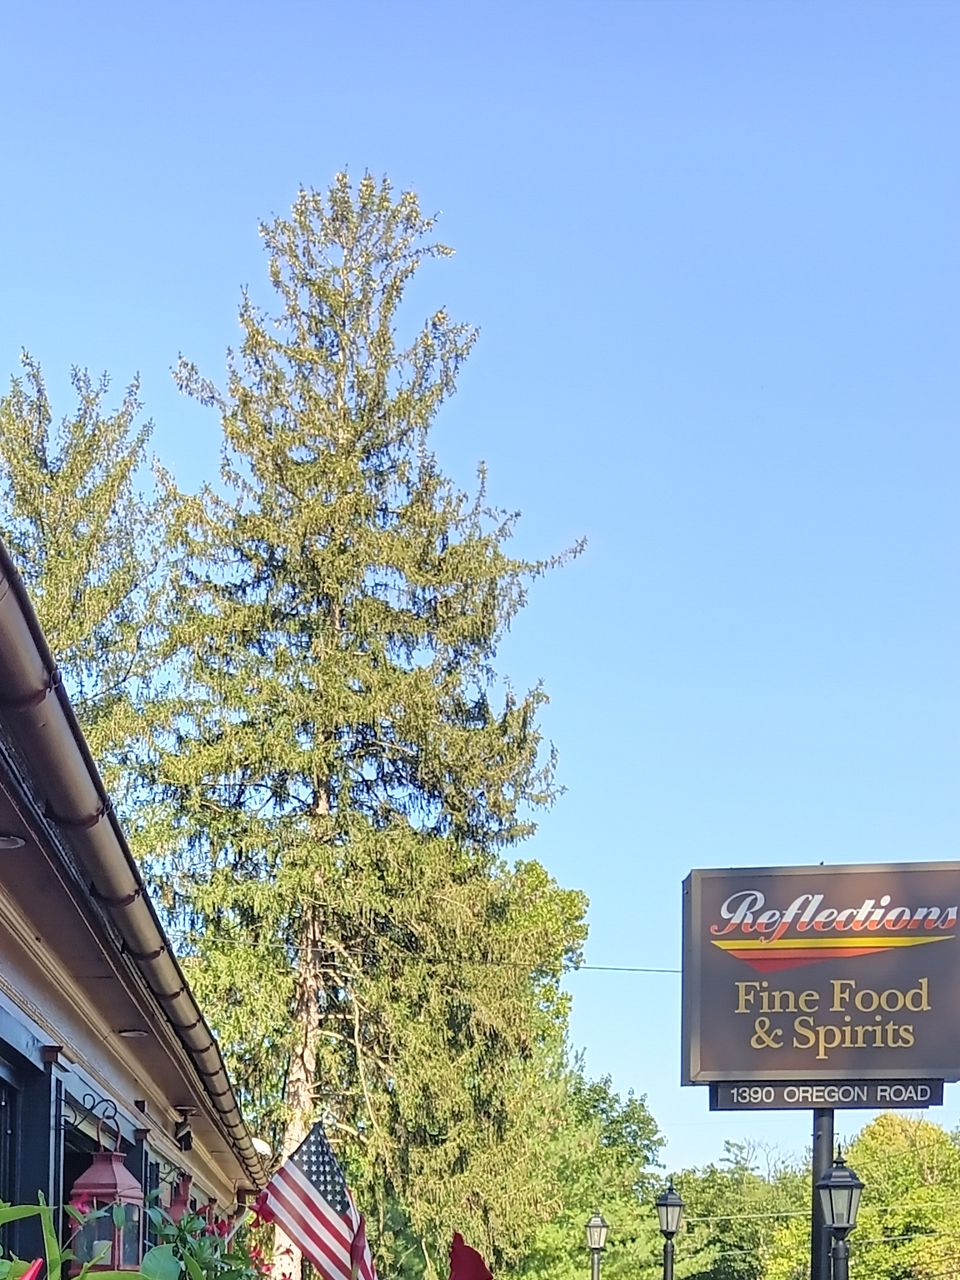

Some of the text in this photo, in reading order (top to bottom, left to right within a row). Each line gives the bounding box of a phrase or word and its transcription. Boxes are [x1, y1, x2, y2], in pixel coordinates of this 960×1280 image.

[710, 890, 959, 943] Reflections
[734, 977, 931, 1013] Fine Food
[750, 1015, 915, 1060] & Spirits
[730, 1084, 931, 1103] 1390 OREGON ROAD
